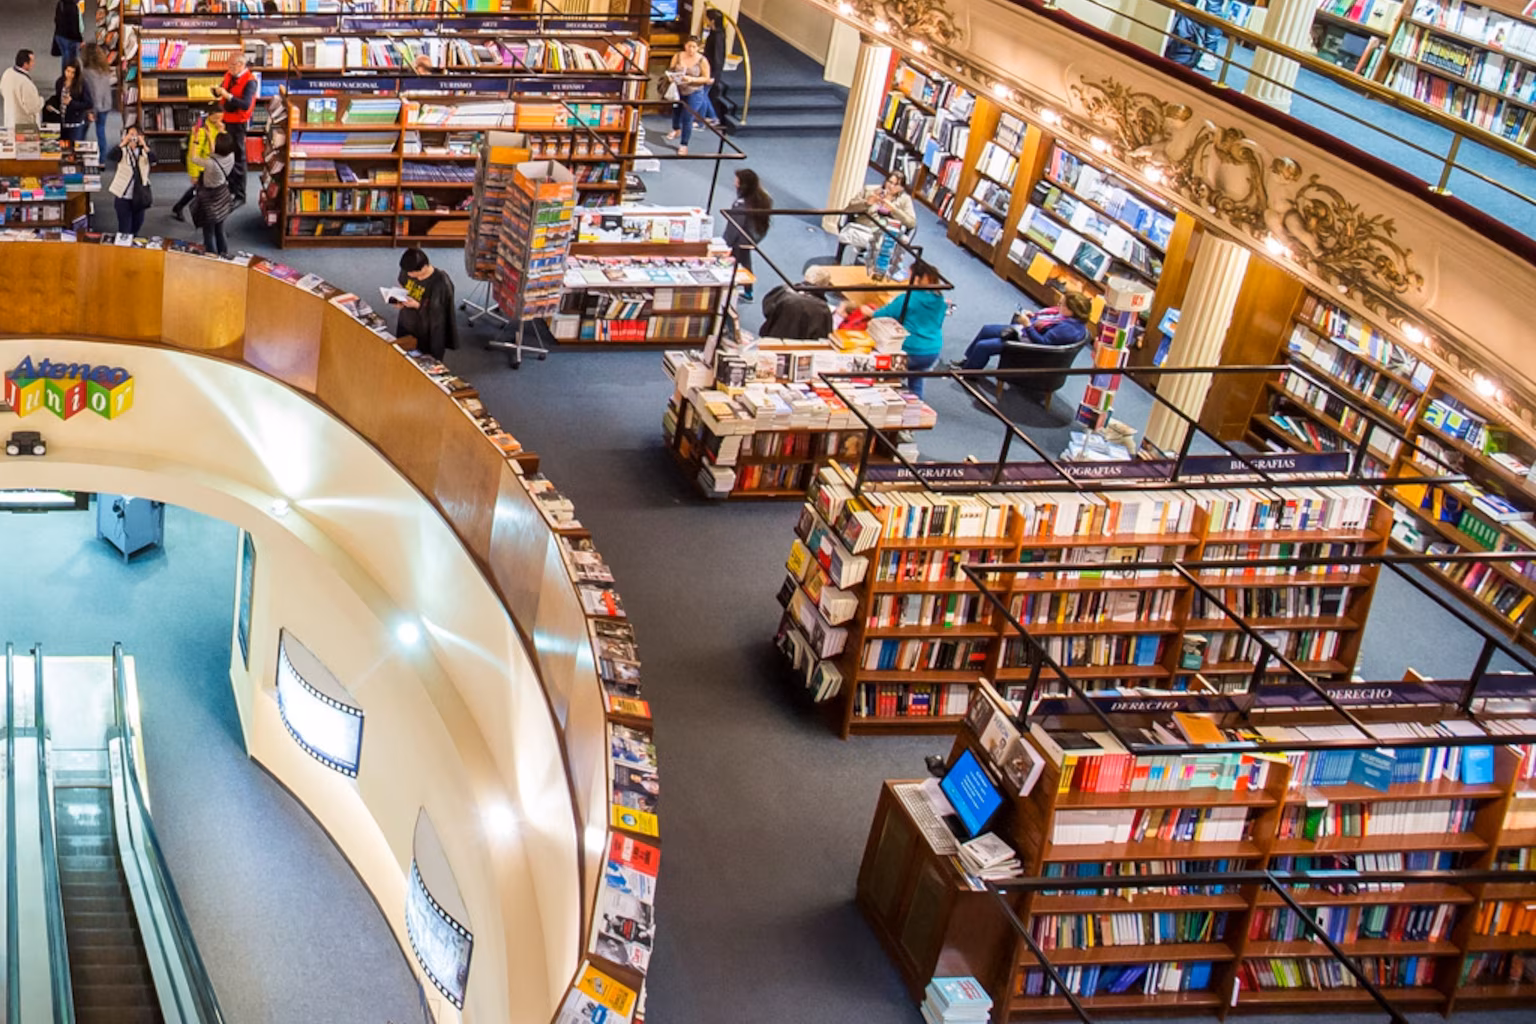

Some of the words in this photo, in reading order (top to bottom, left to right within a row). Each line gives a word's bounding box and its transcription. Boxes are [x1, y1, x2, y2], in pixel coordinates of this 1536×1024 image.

[309, 81, 341, 89] TURISMO
[8, 355, 131, 385] Ateneo
[5, 380, 132, 413] Junior
[1326, 687, 1394, 700] DERECHO
[1110, 700, 1180, 711] DERECHO
